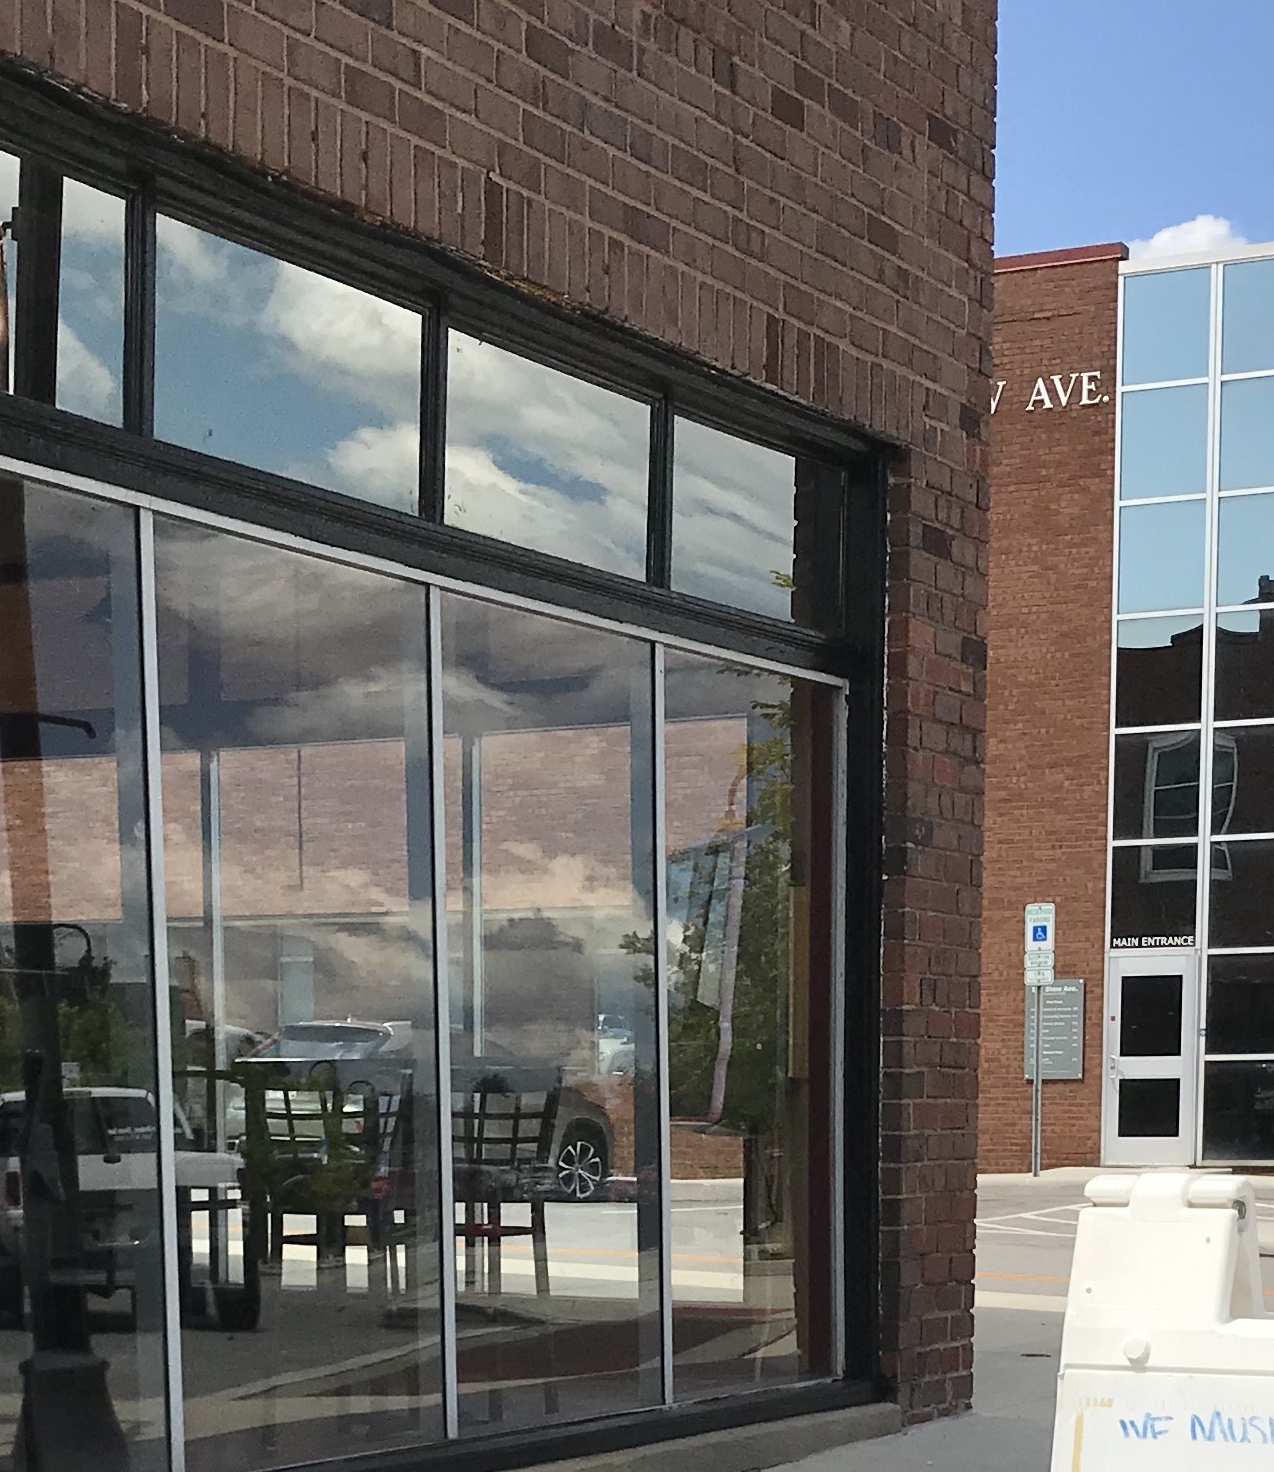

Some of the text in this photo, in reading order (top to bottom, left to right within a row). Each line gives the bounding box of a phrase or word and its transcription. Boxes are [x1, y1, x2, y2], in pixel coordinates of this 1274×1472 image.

[1026, 371, 1109, 411] AVE.
[1113, 936, 1194, 947] MAIN ENTRANCE
